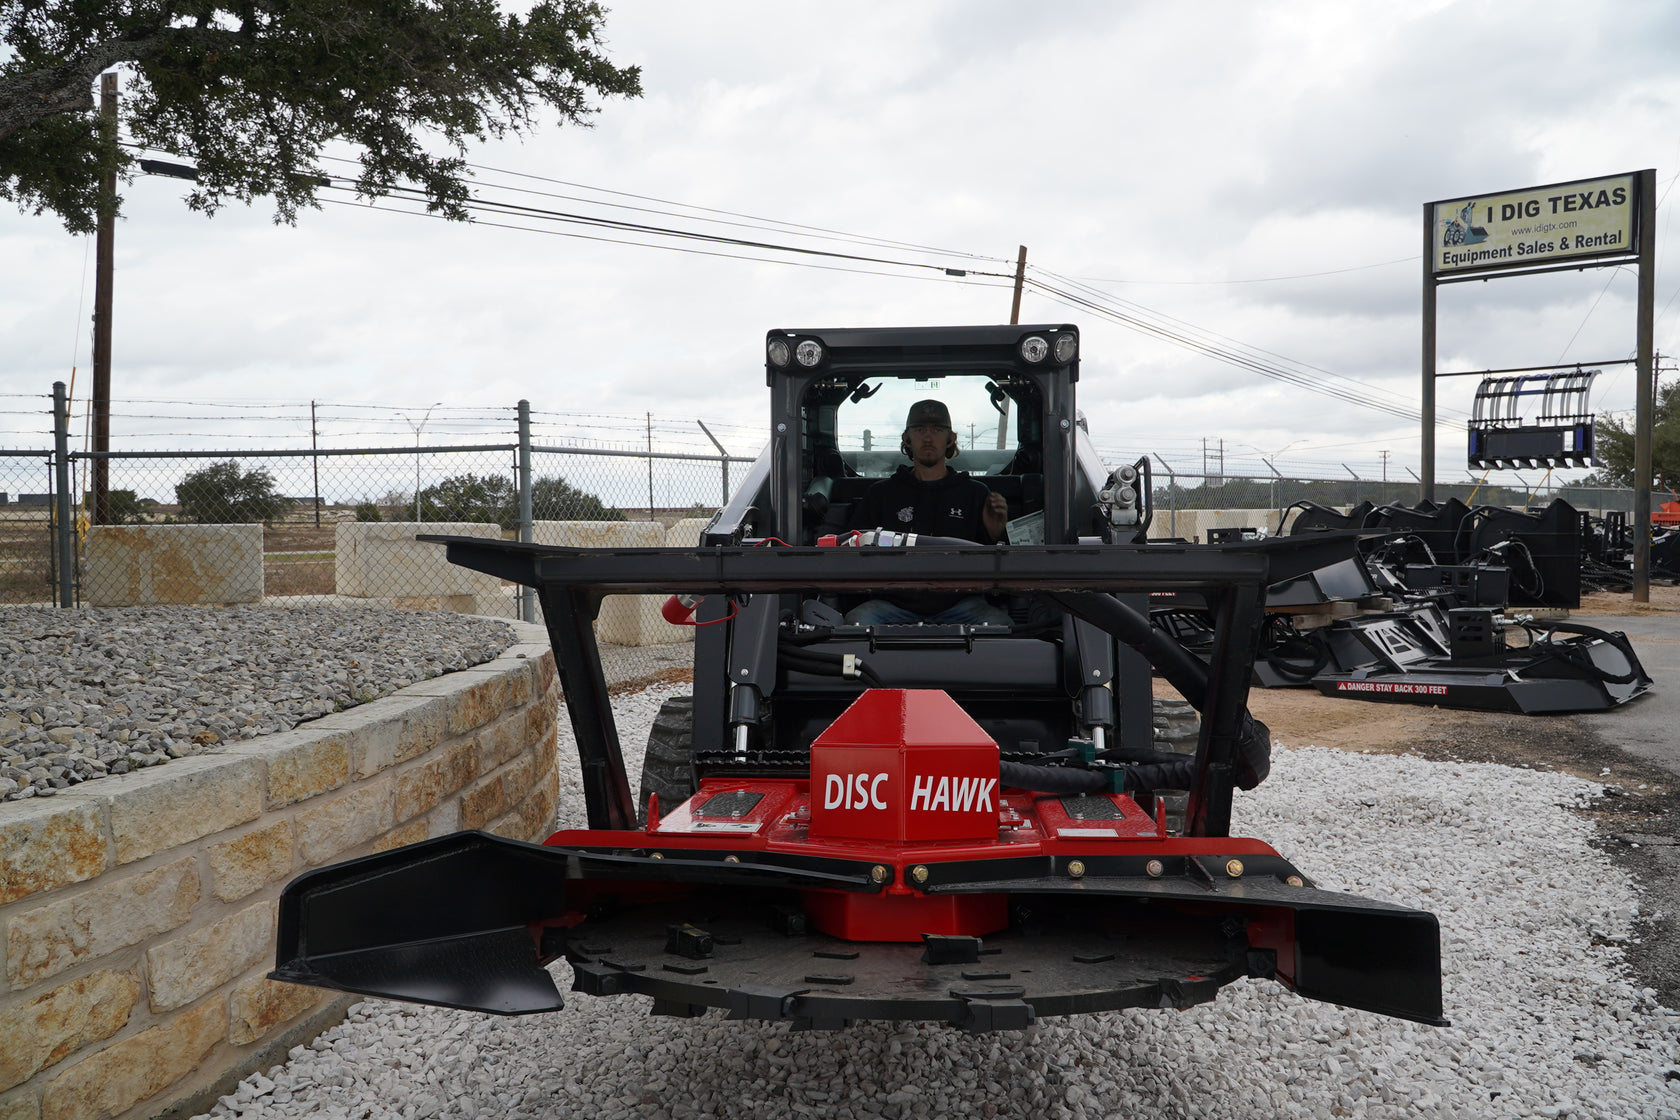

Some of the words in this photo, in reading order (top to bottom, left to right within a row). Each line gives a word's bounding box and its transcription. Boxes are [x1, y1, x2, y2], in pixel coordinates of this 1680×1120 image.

[1487, 206, 1493, 224] I
[1501, 199, 1540, 222] DIG
[1548, 187, 1627, 214] TEXAS
[1511, 220, 1578, 236] www.idigtx.com
[1443, 244, 1512, 266] Equipment
[1517, 240, 1554, 256] Sales
[1560, 236, 1570, 251] &
[1575, 229, 1622, 249] Rental
[1347, 682, 1375, 692] DANGER
[1376, 684, 1393, 693] STAY
[1394, 684, 1414, 693] BACK
[1414, 685, 1428, 694] 300
[1429, 686, 1447, 695] FEET
[824, 772, 889, 810] DISC
[910, 775, 998, 813] HAWK
